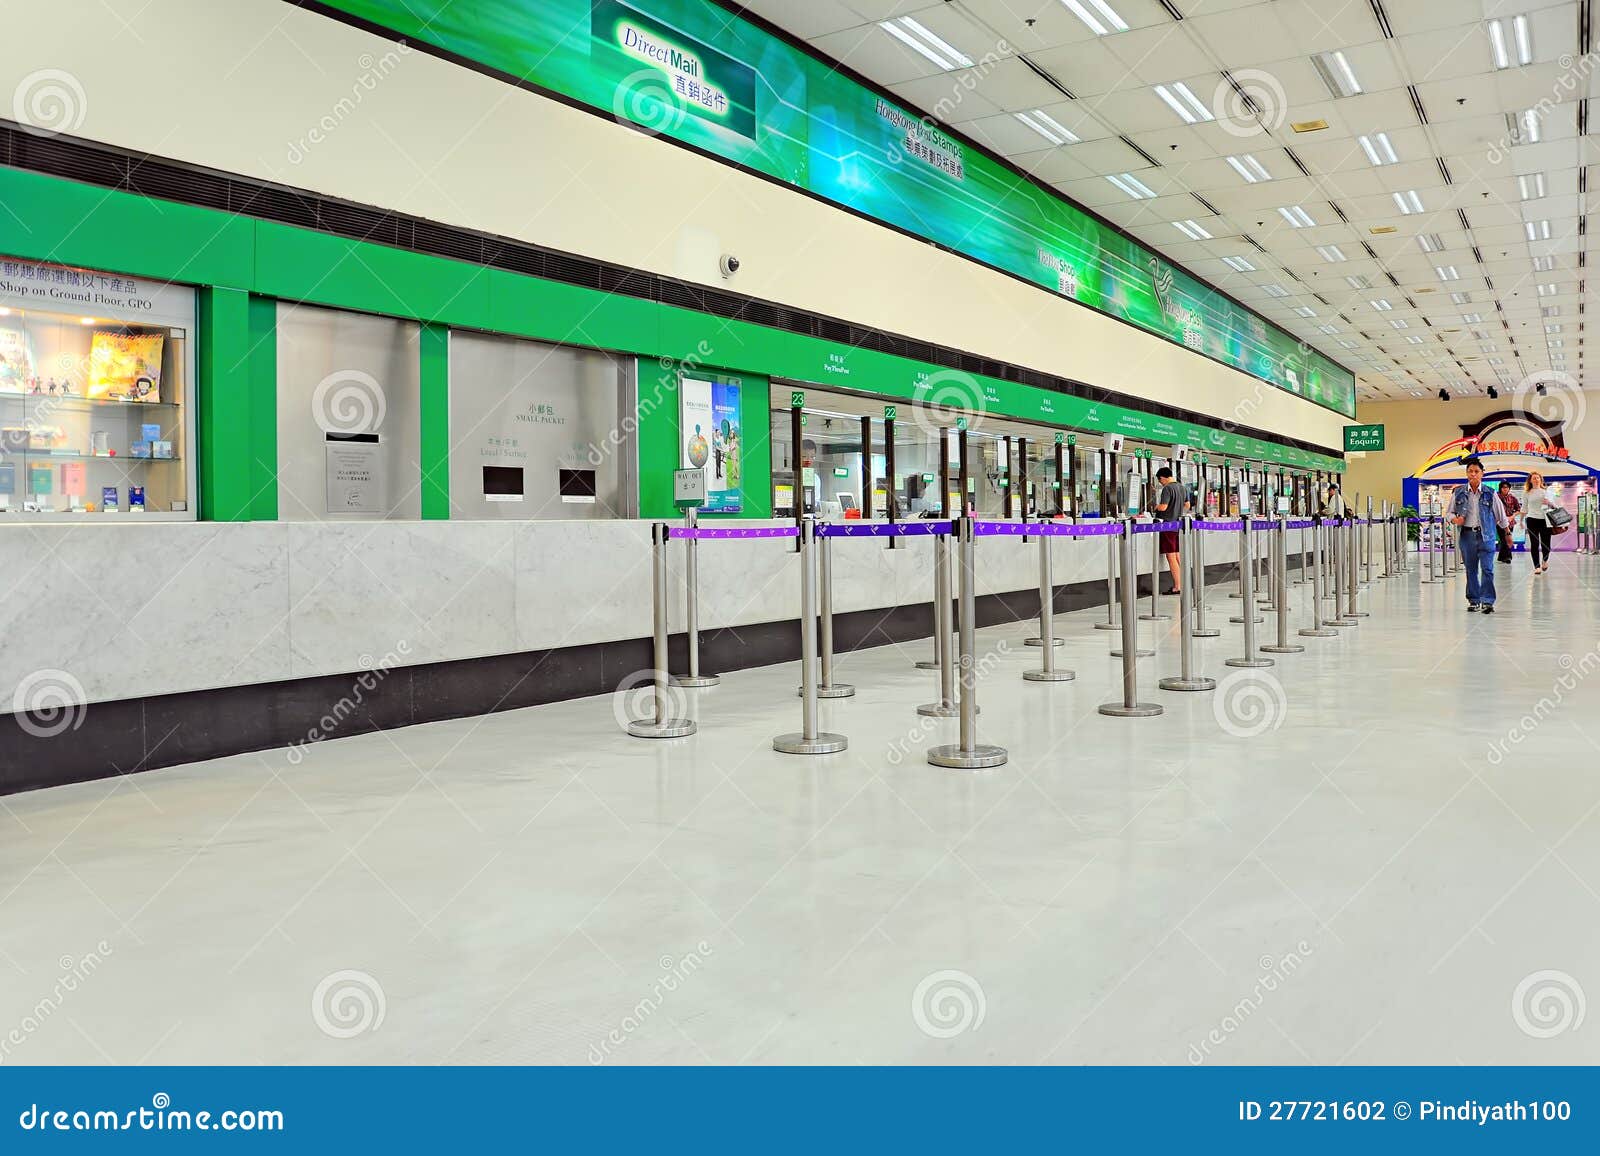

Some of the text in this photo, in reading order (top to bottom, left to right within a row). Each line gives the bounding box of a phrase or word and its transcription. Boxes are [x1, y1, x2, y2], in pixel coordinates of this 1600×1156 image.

[675, 74, 727, 112] 直銷函件
[0, 281, 153, 311] Shop on Ground Floor, GPO
[792, 393, 804, 406] 23
[885, 406, 896, 419] 22
[1350, 437, 1380, 447] Enquiry
